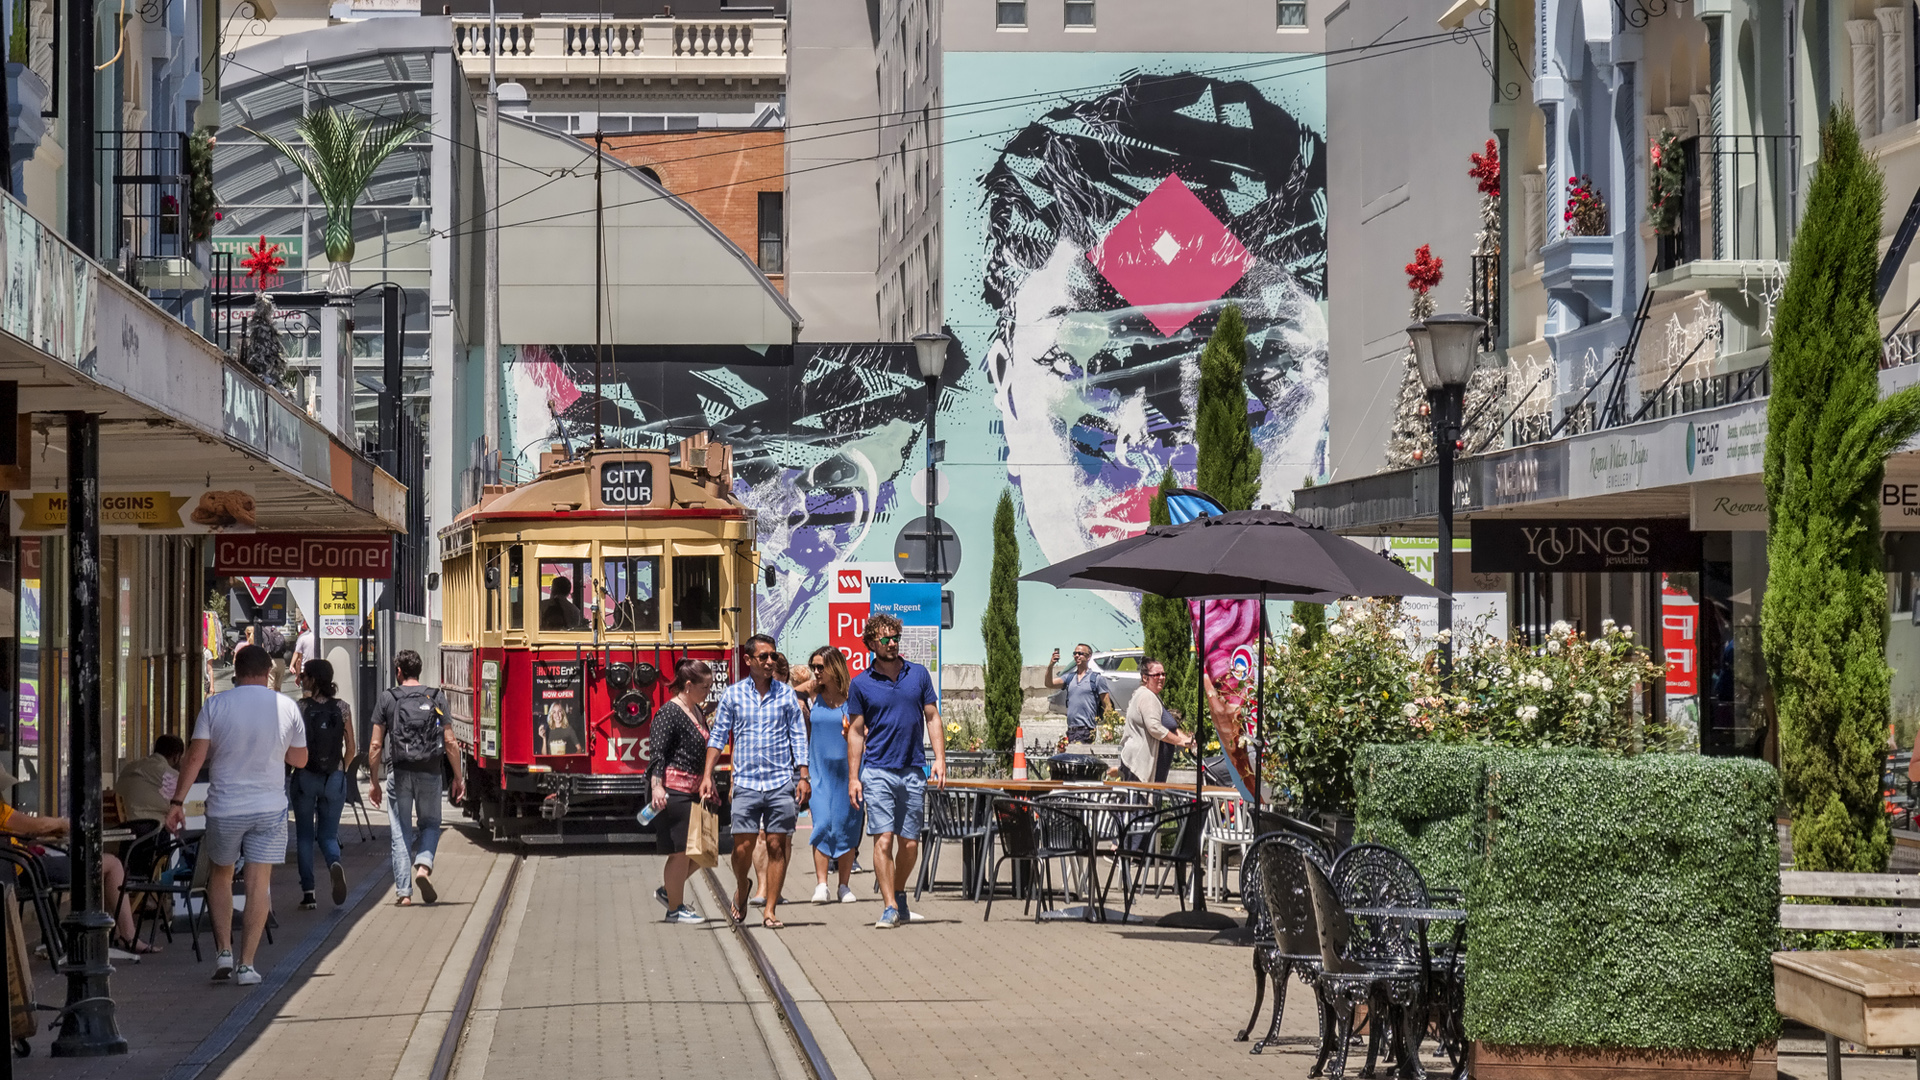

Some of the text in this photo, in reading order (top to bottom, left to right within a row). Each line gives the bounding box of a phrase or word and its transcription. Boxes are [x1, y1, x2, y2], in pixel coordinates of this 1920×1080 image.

[212, 241, 298, 255] ATHEDAL
[251, 276, 284, 288] TRU
[1697, 423, 1720, 455] BEADZ
[606, 469, 646, 484] CITY
[602, 486, 651, 502] TOUR
[101, 497, 154, 510] GGINS
[44, 512, 67, 521] OVE
[112, 510, 158, 520] COOKIES
[1520, 526, 1650, 565] YOUNGS
[220, 541, 389, 567] Coffee Corner
[1605, 553, 1649, 567] jewellers
[323, 602, 356, 610] OF TRAMS
[873, 603, 921, 613] New Regent
[712, 672, 728, 681] TOP
[543, 690, 573, 698] NOW OPEN
[710, 683, 728, 693] ASA
[606, 737, 650, 761] 178
